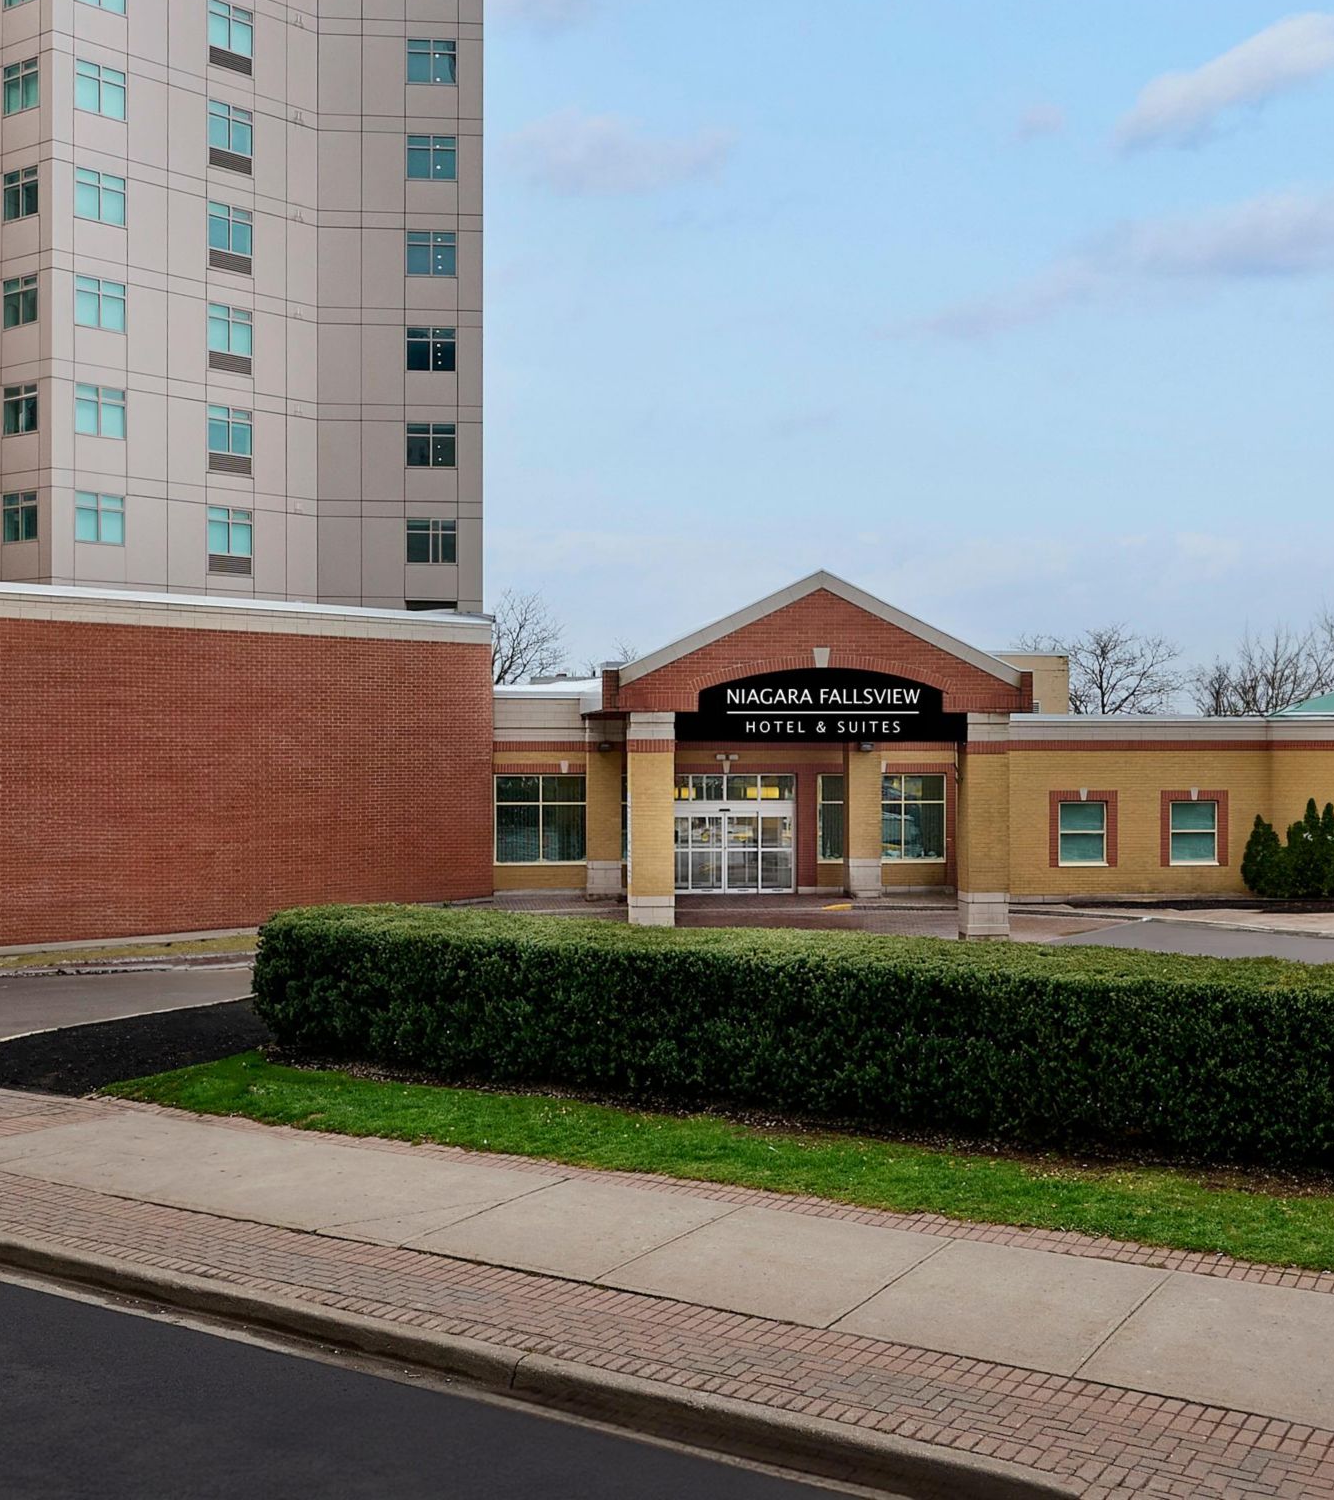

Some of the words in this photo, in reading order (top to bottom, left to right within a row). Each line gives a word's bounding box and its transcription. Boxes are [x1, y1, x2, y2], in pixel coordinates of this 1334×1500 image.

[727, 688, 813, 704] NIAGARA
[820, 688, 921, 704] FALLSVIEW
[746, 721, 806, 733] HOTEL
[816, 721, 826, 733] &
[837, 721, 901, 733] SUITES
